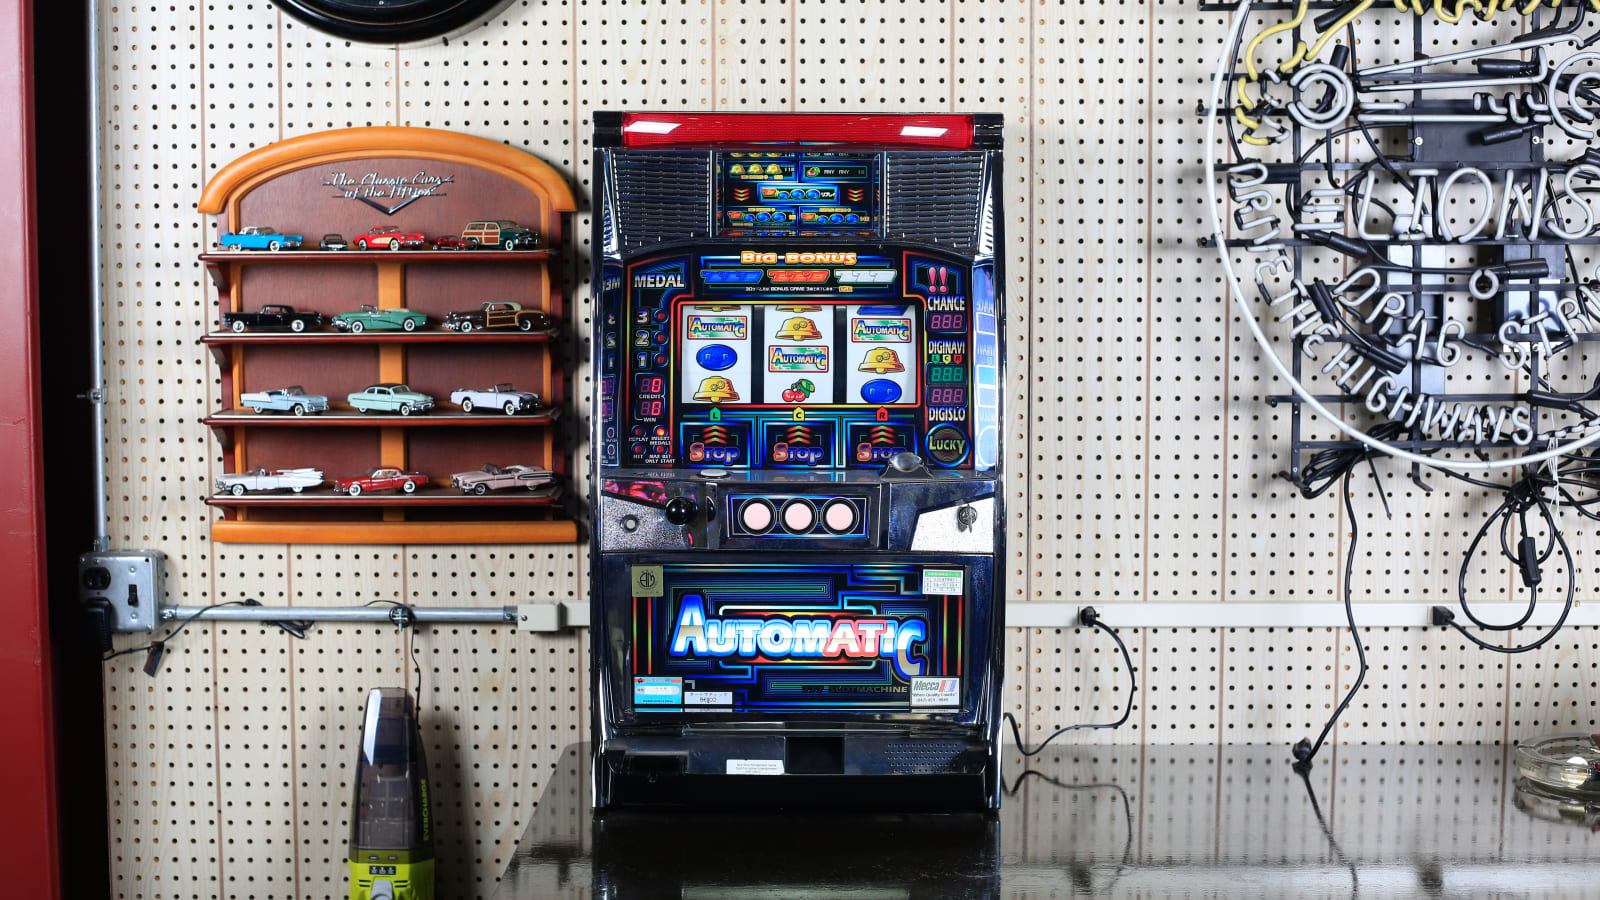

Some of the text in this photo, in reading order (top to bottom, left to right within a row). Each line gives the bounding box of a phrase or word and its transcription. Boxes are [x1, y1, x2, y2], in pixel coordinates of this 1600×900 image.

[634, 273, 685, 288] MEDAL
[927, 295, 966, 311] CHANCE
[637, 310, 648, 323] 3
[690, 317, 745, 337] AUTOMATIC
[854, 320, 909, 341] AUTOMATIC
[636, 331, 649, 345] 2
[928, 340, 965, 354] DIGINAVI
[638, 353, 647, 368] 1
[772, 347, 827, 370] AUTOMATIC
[928, 406, 966, 421] DIGISLO
[929, 436, 965, 454] LUCKY
[857, 443, 905, 463] STO
[670, 594, 926, 681] AUTOMATIC
[914, 680, 939, 691] Mecca
